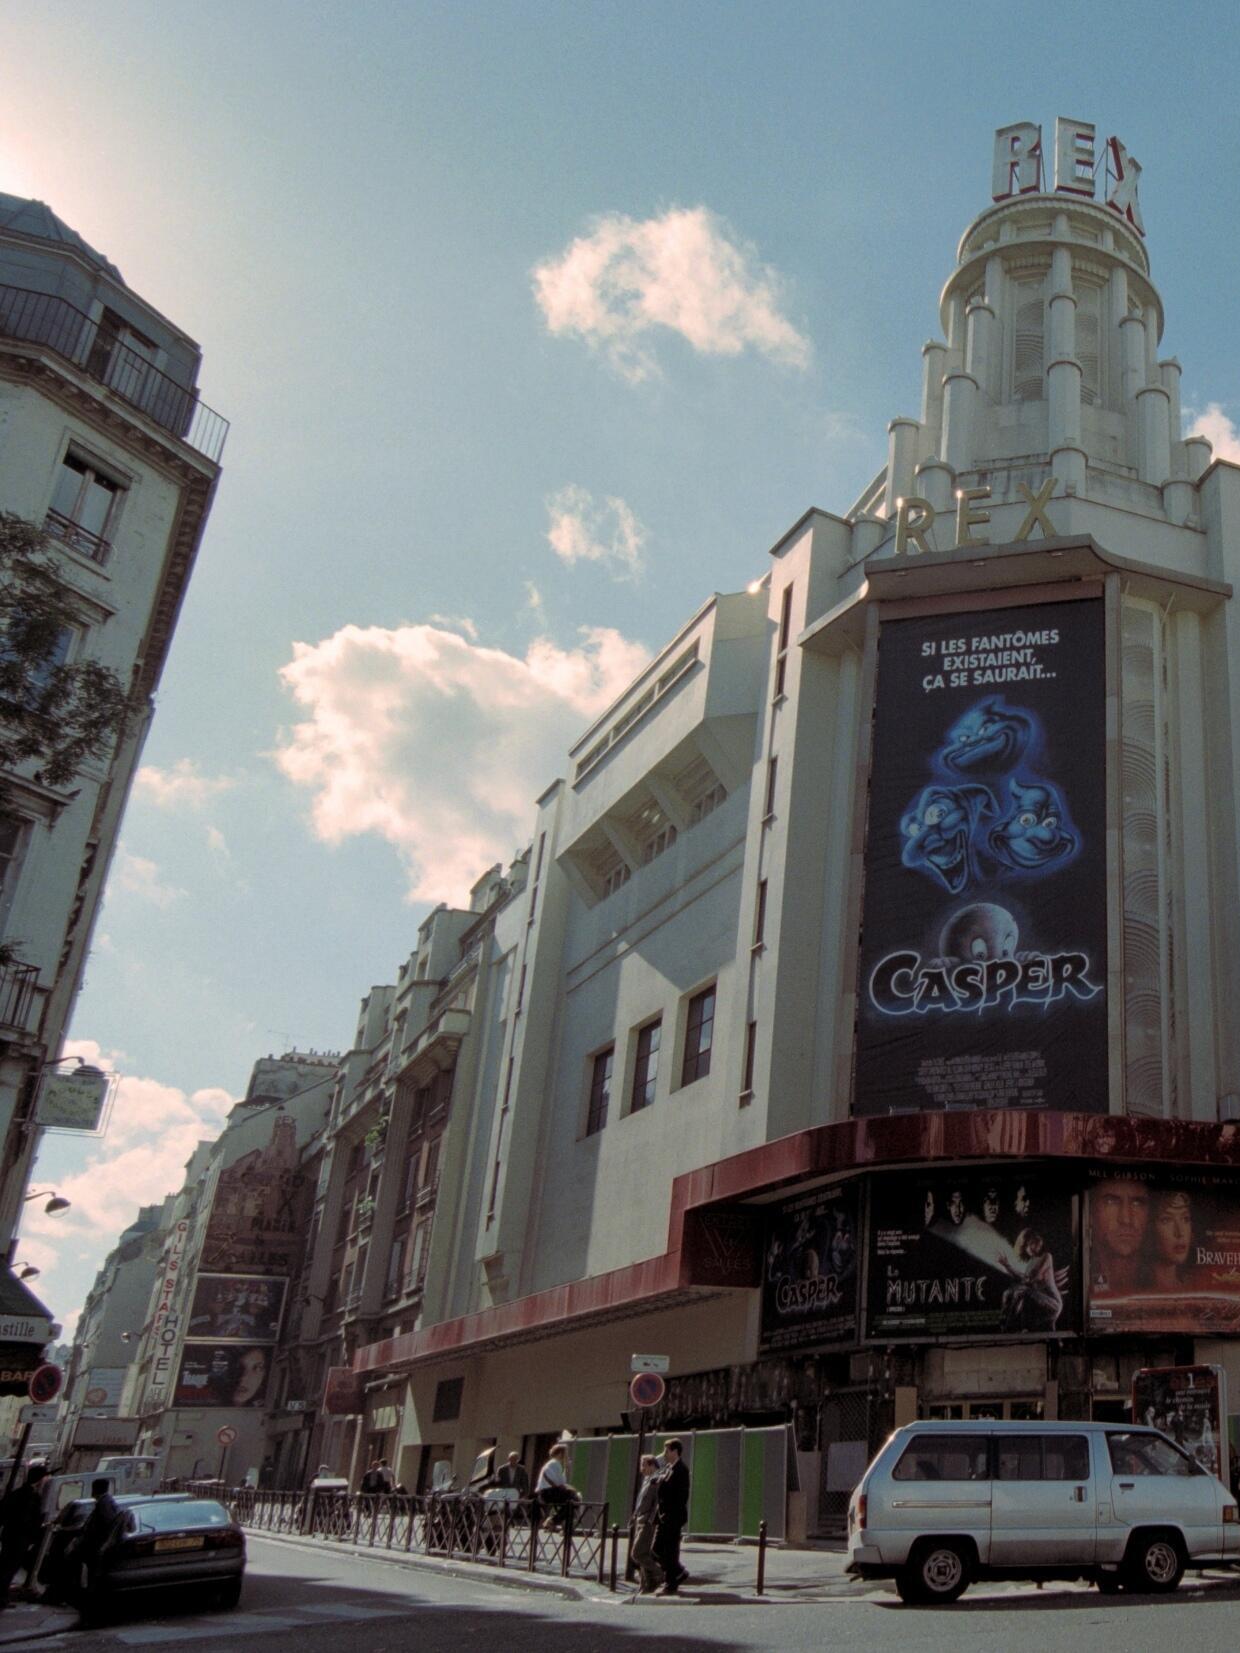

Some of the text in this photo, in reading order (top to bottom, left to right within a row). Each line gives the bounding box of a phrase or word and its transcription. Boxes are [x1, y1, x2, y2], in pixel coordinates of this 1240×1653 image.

[992, 117, 1146, 237] REX
[895, 477, 1058, 554] REX
[921, 629, 1060, 656] SI LES FANTÔMES
[943, 649, 1037, 671] EXISTAIENT,
[923, 664, 1057, 693] ÇA SE SAURAIT...
[886, 1275, 988, 1305] MUTANTE
[152, 1315, 179, 1386] HOTEL
